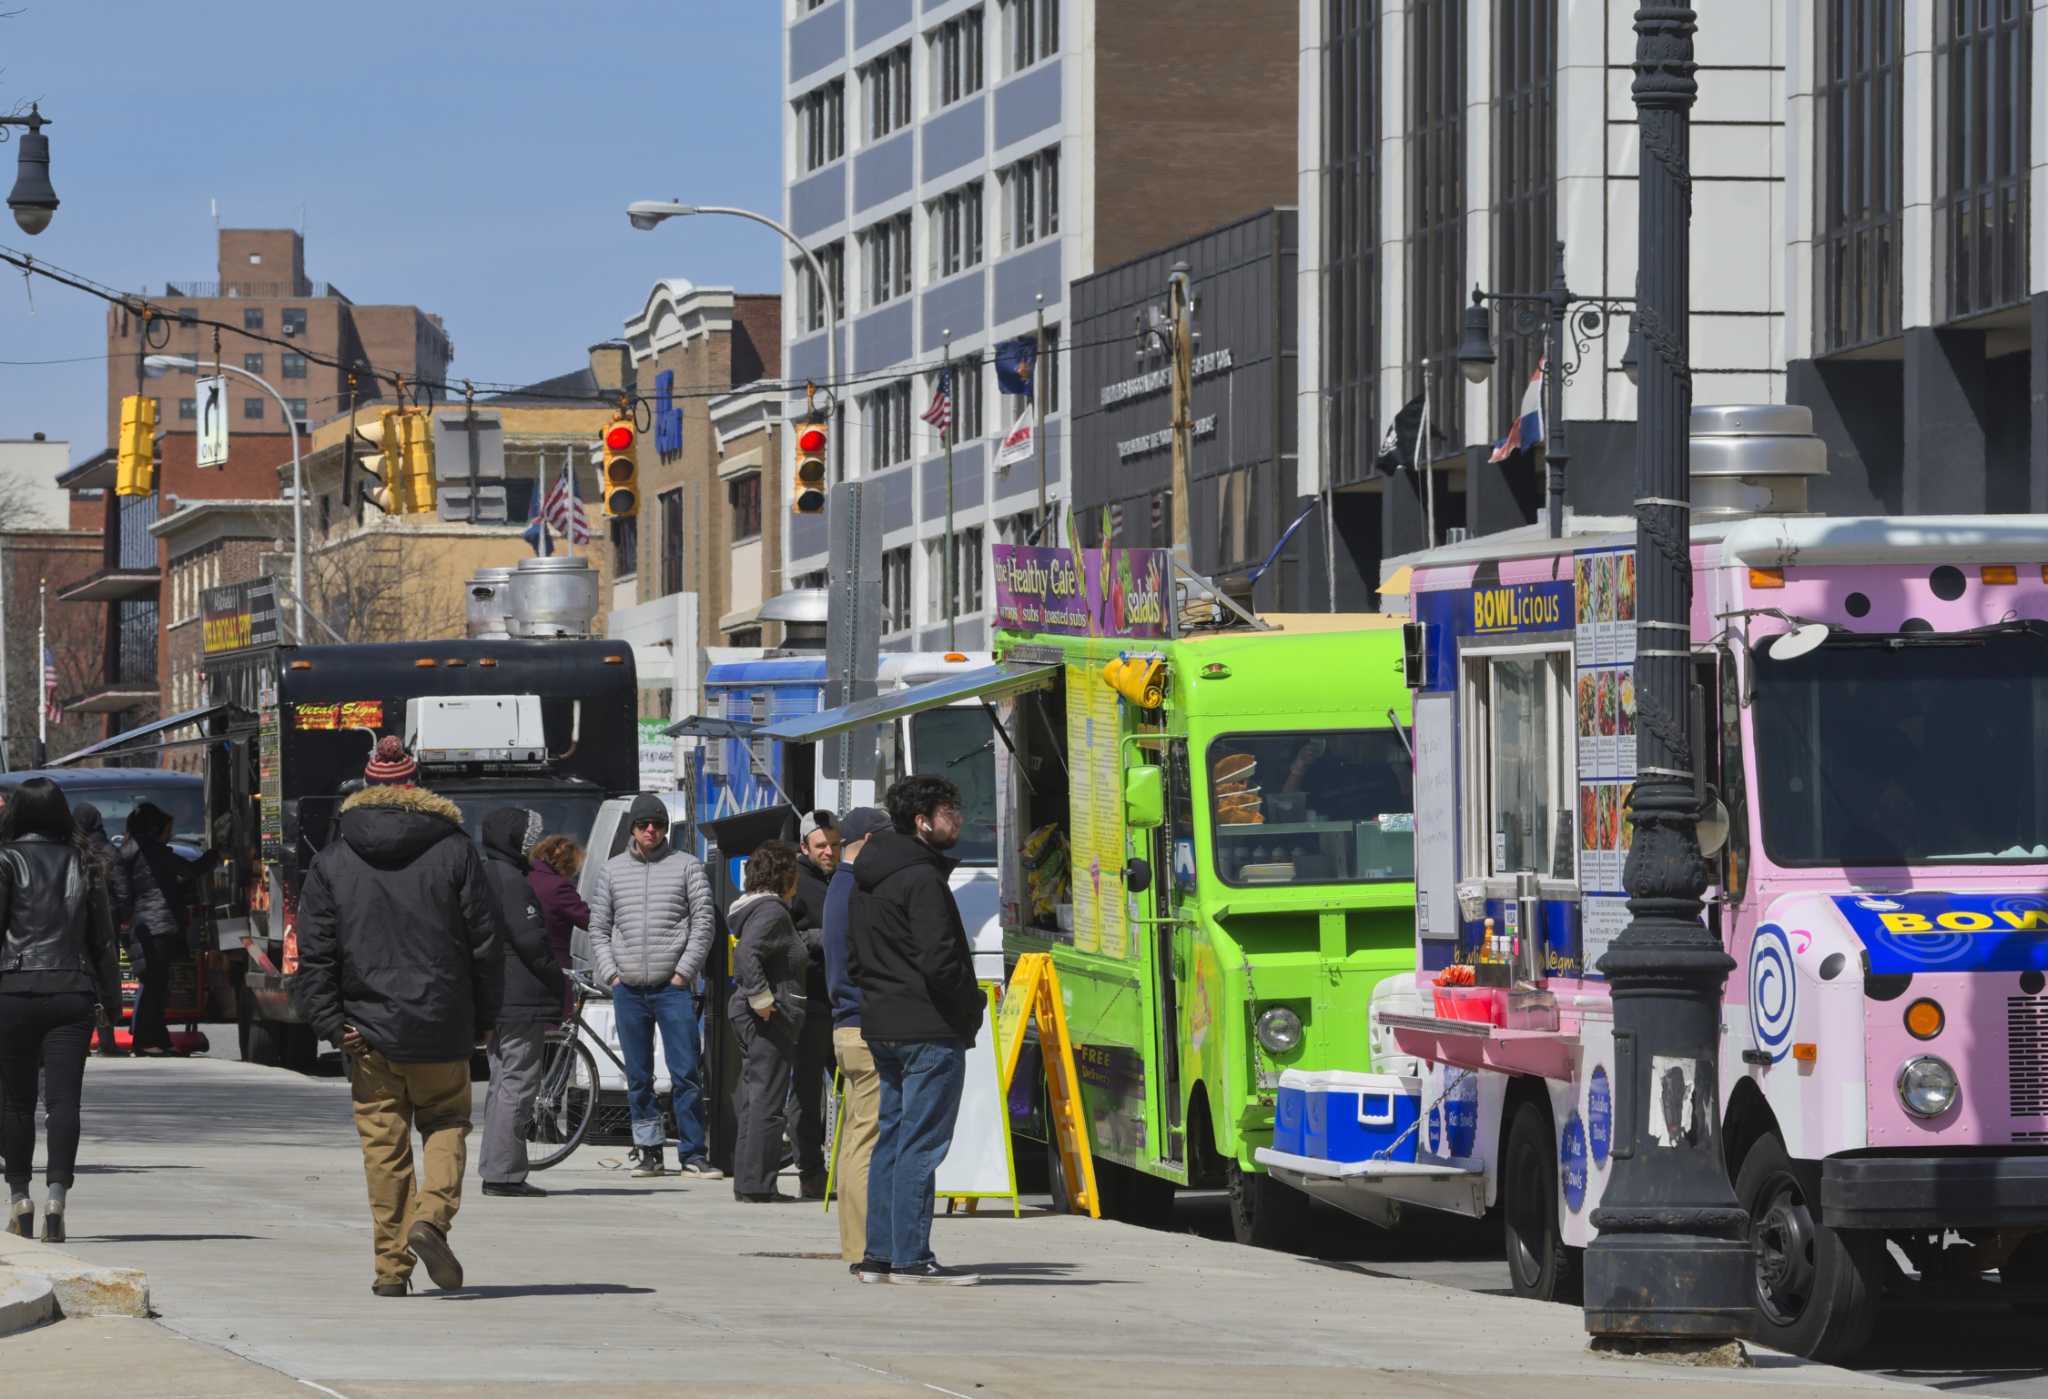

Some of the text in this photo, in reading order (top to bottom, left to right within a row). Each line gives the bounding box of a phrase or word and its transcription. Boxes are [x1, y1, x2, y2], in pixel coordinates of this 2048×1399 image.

[1007, 557, 1048, 602] Healthy
[1050, 559, 1075, 595] Cafe
[1023, 604, 1039, 622] subs
[1044, 608, 1069, 625] toasted
[1070, 609, 1087, 627] subs
[1127, 579, 1160, 623] salads
[1473, 586, 1559, 629] BOWLicious
[296, 702, 378, 717] Vital Sign
[1081, 1047, 1111, 1067] FREE
